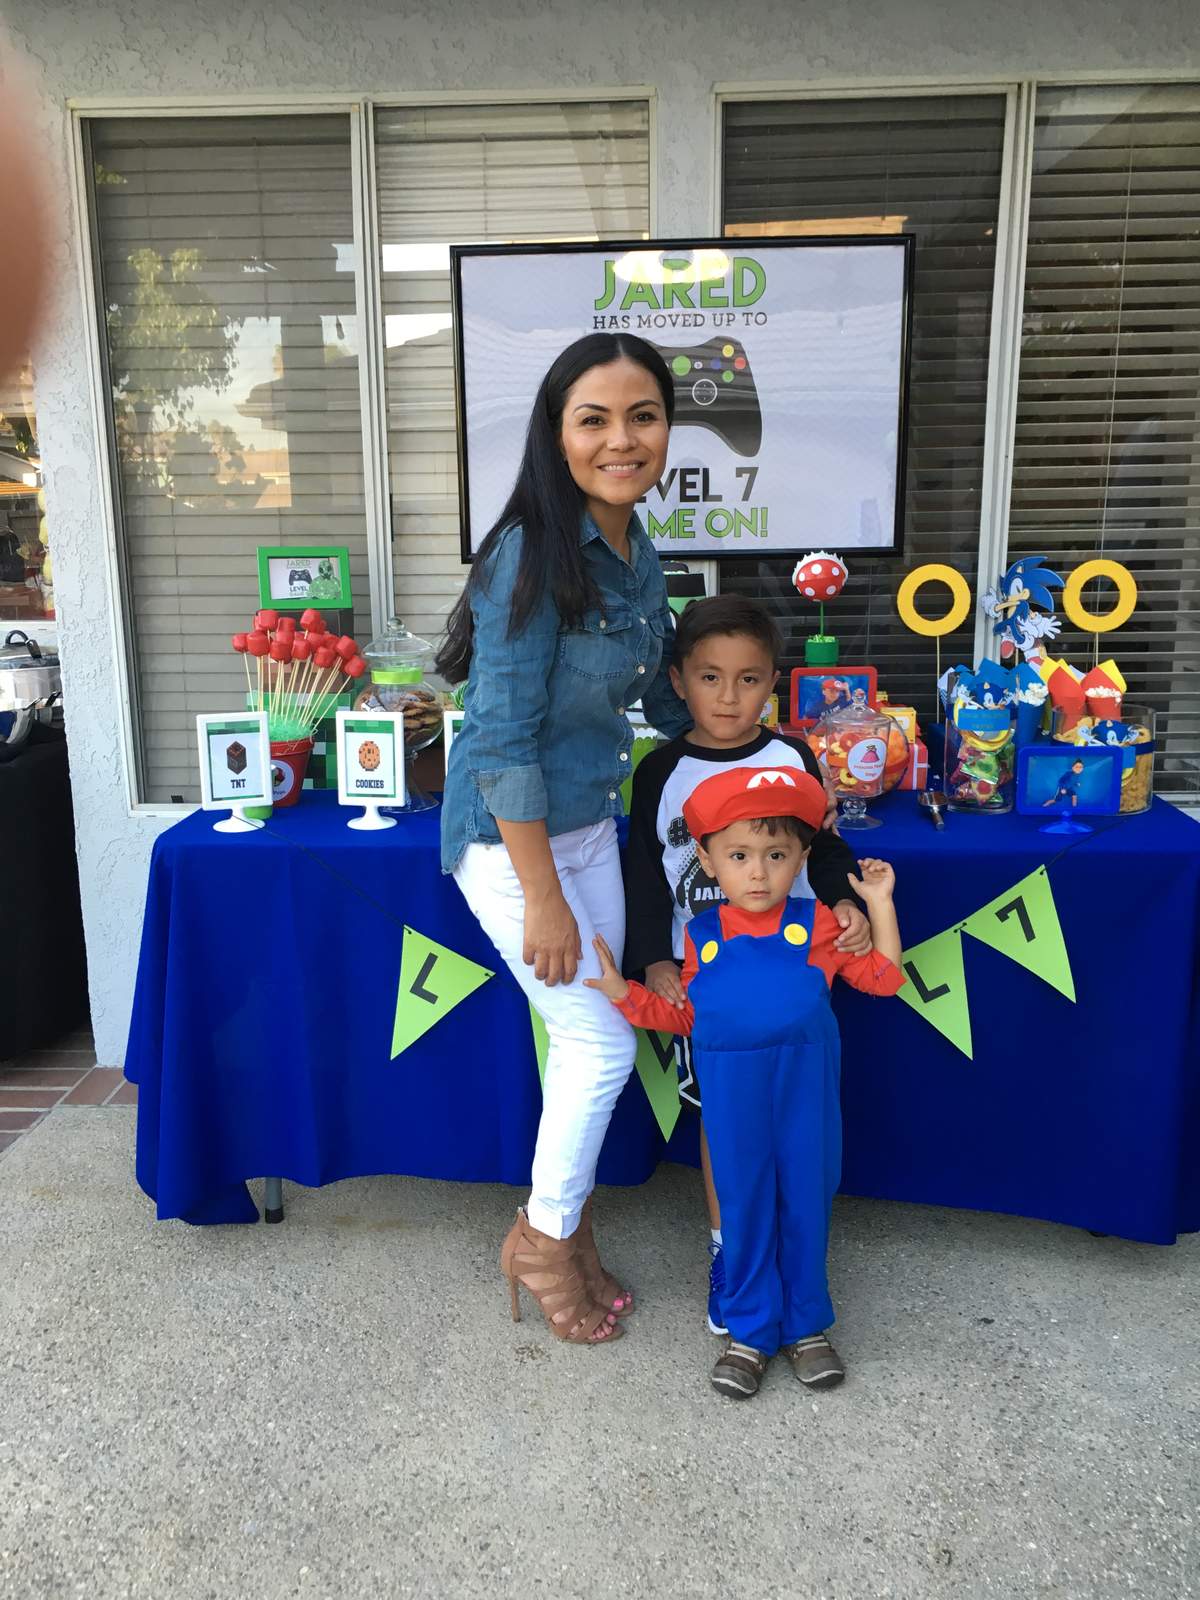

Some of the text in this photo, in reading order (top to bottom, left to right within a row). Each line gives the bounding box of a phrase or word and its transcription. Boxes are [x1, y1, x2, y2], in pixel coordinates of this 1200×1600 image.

[594, 257, 767, 311] JARED
[593, 312, 768, 330] HAS MOVED UP TO
[735, 466, 760, 502] 7
[647, 507, 769, 538] ME ON!
[230, 778, 247, 789] TNT
[355, 778, 385, 789] COOKIES
[409, 951, 438, 1005] L
